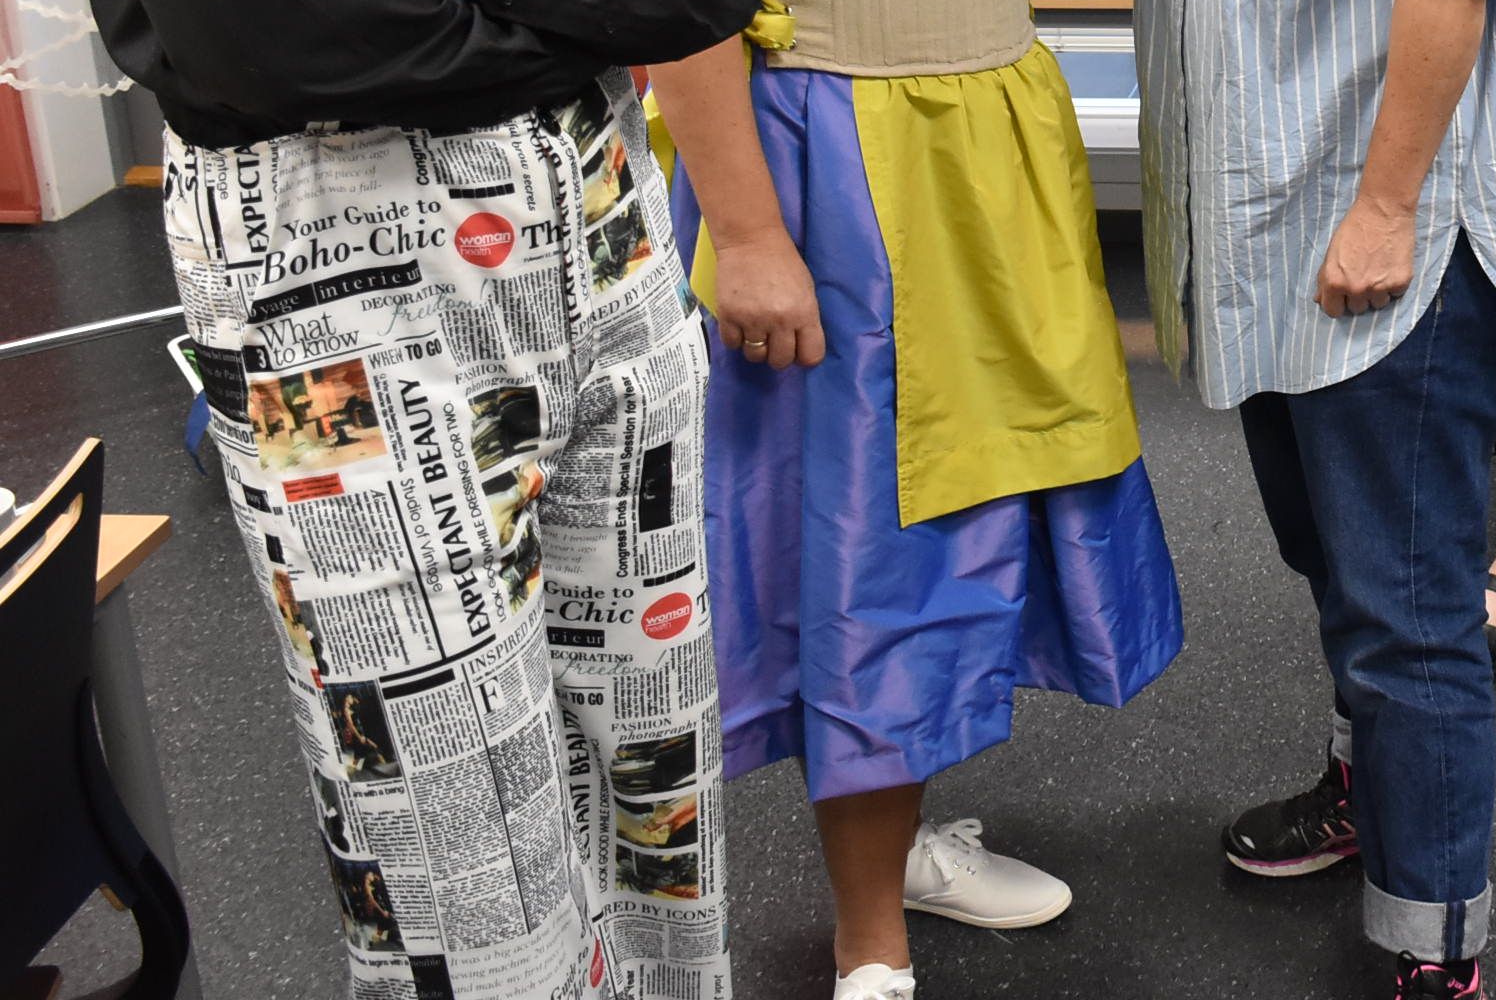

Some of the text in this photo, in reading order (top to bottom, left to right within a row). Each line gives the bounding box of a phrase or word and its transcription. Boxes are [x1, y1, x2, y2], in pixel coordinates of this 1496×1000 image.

[511, 141, 529, 170] brow
[522, 173, 537, 212] secrets
[281, 198, 443, 242] Your Guide to
[260, 218, 447, 286] Boho-Chic
[458, 231, 512, 247] woman
[360, 281, 458, 313] DECORATING
[623, 286, 641, 307] BY
[639, 261, 668, 293] ICONS
[256, 310, 339, 351] What
[256, 347, 268, 369] 3
[272, 345, 297, 367] to
[299, 329, 361, 359] know
[404, 342, 424, 361] TO
[425, 337, 443, 357] GO
[454, 362, 509, 386] FASHION
[464, 371, 536, 397] photography
[397, 378, 449, 485] BEAUTY
[442, 400, 460, 433] TWO
[450, 432, 465, 459] FOR
[457, 459, 483, 519] DRESSING
[615, 375, 637, 579] Congress Ends Special Session for Year
[400, 477, 444, 593] Studio of Vintage
[473, 518, 495, 554] WHILE
[429, 492, 492, 638] EXPECTANT
[543, 580, 635, 600] Guide to
[491, 591, 508, 623] LOOK
[544, 599, 635, 625] -Chic
[645, 604, 691, 626] woman
[467, 621, 529, 675] INSPIRED
[571, 692, 586, 706] TO
[587, 691, 605, 707] GO
[610, 716, 673, 734] FASHION
[617, 719, 700, 744] photography
[598, 834, 610, 865] GOOD
[641, 903, 664, 919] BY
[666, 904, 718, 921] ICONS
